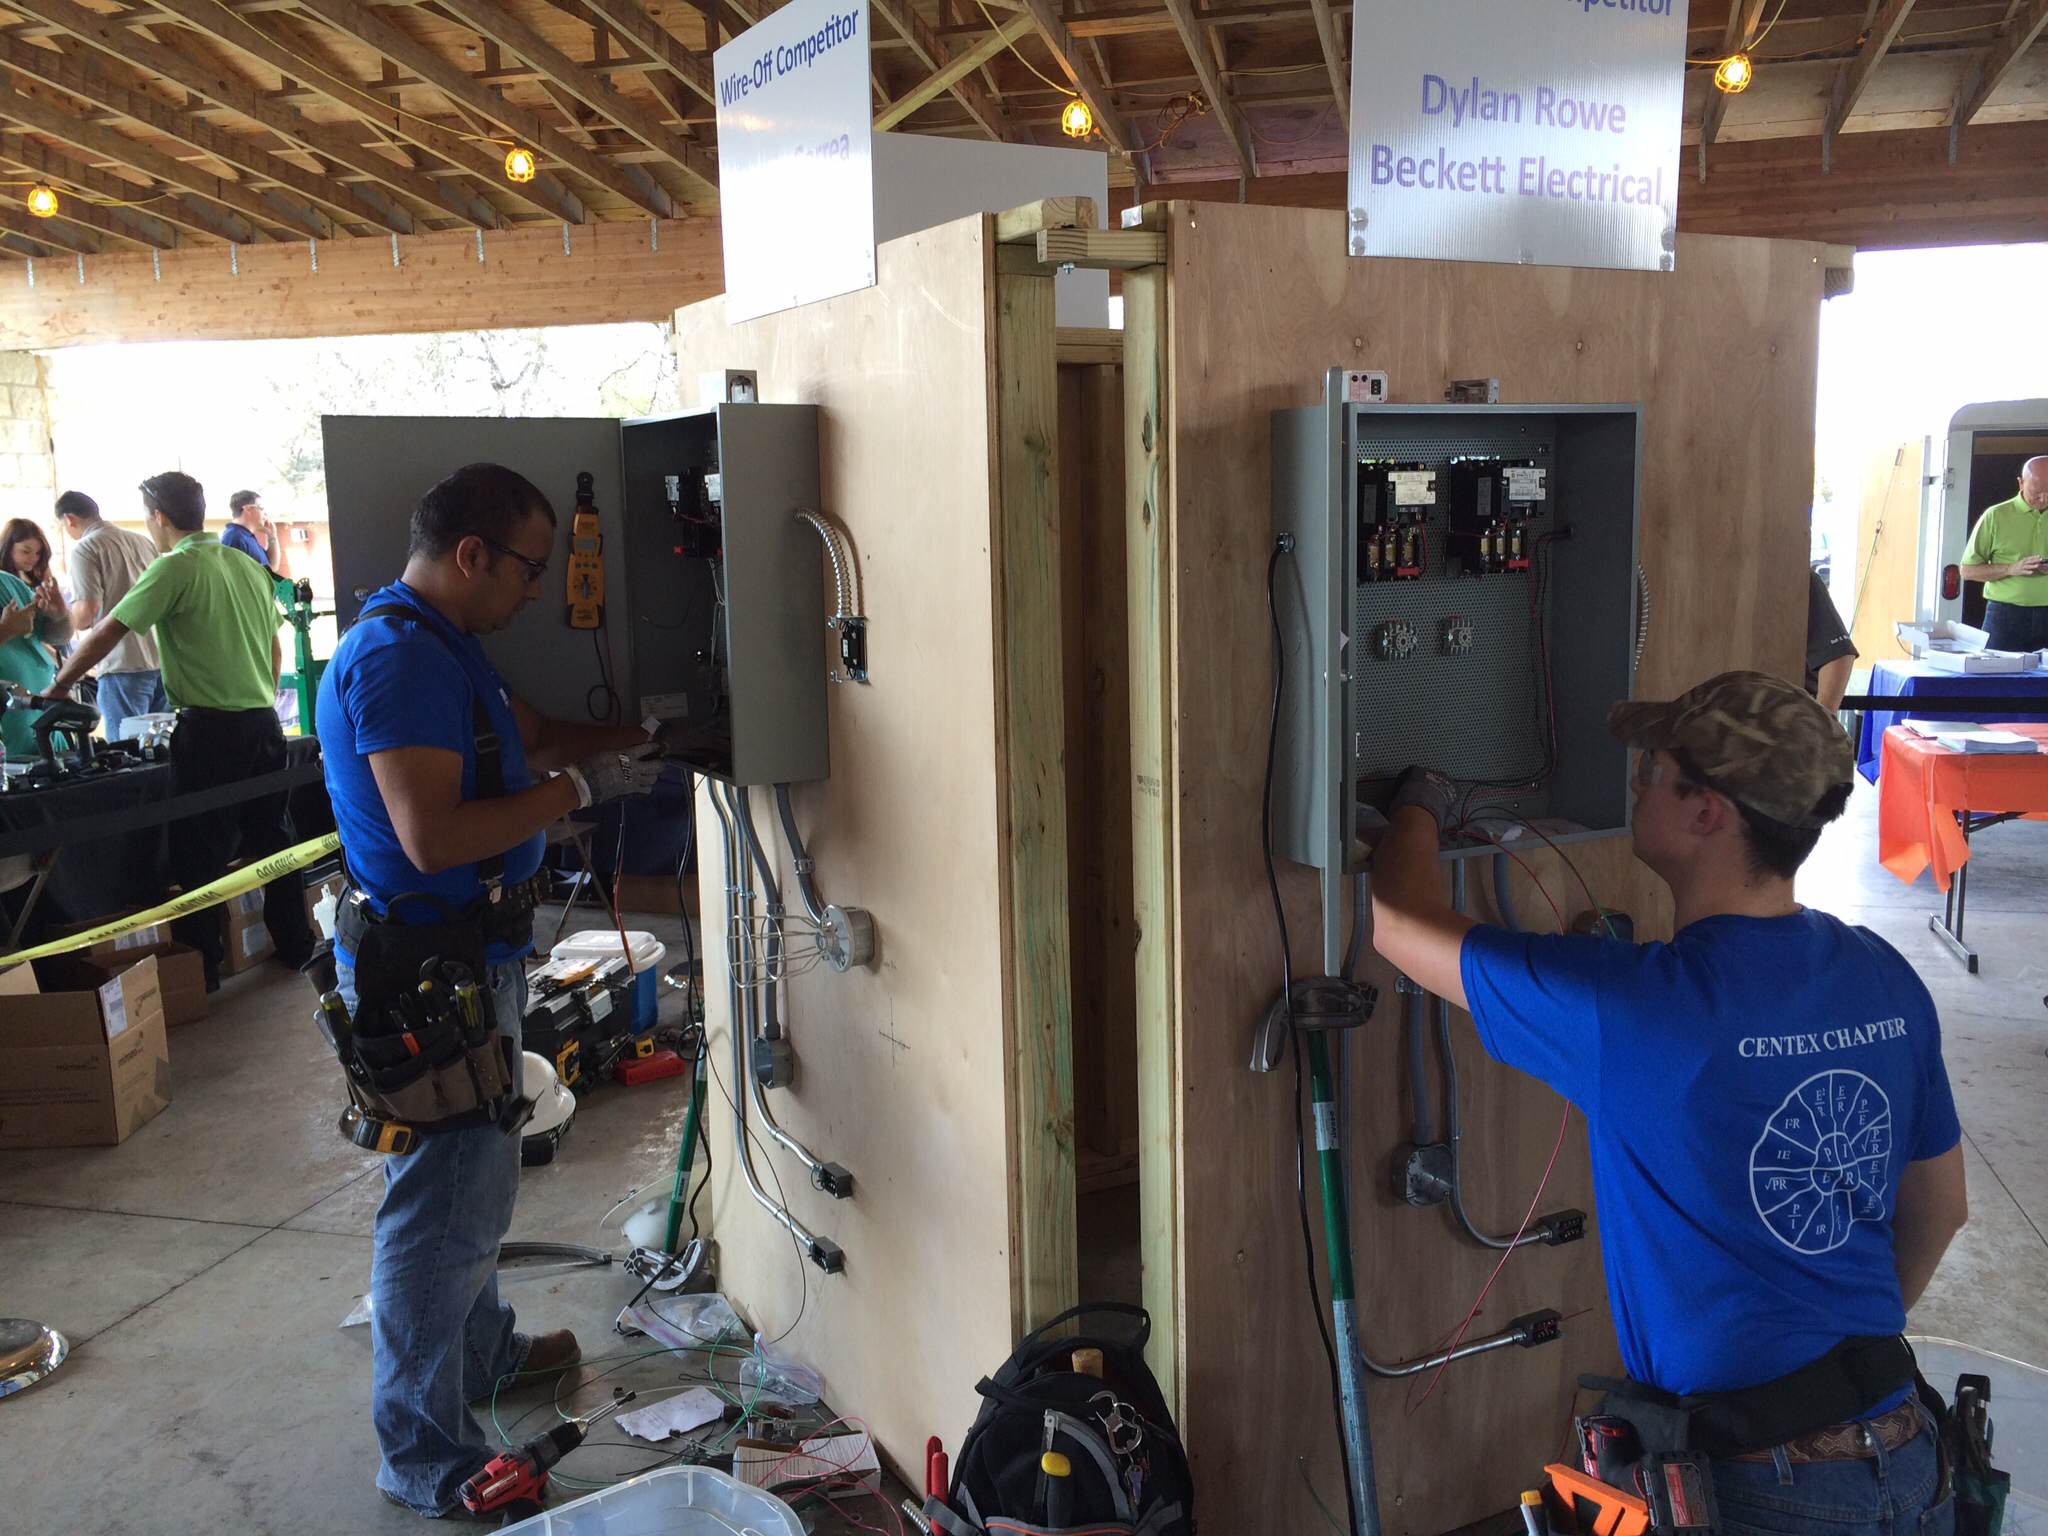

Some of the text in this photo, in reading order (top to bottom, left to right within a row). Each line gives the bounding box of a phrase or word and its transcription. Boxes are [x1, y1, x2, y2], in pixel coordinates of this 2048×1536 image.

[721, 9, 859, 107] Wire-Off Competitor
[1421, 74, 1626, 133] Dylan Rowe
[1371, 144, 1662, 205] Beckett Electrical
[1738, 1017, 1907, 1058] CENTEX CHAPTER
